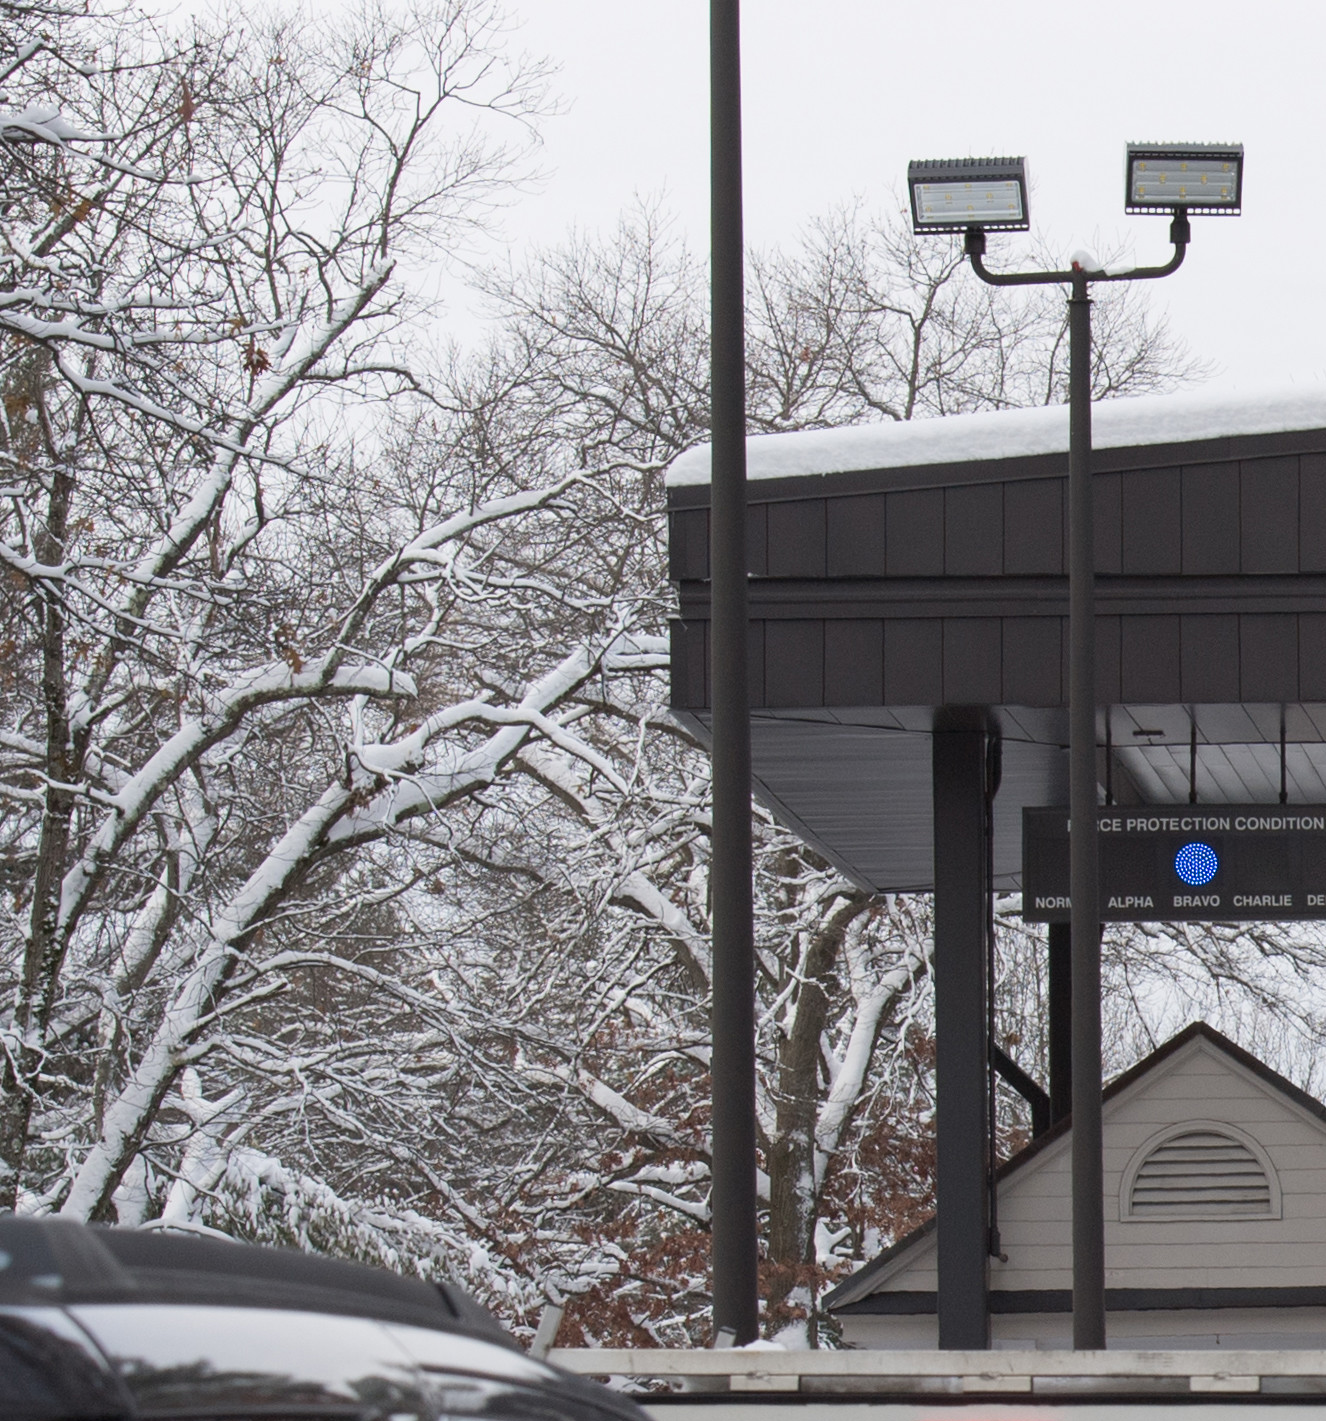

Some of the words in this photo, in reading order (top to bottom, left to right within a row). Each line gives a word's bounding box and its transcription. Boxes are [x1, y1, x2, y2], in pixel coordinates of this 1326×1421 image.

[1126, 817, 1230, 832] PROTECTION
[1234, 816, 1325, 830] CONDITION
[1035, 897, 1072, 909] NORM
[1108, 896, 1154, 908] ALPHA
[1173, 895, 1221, 908] BRAVO
[1233, 895, 1293, 907] CHARLIE
